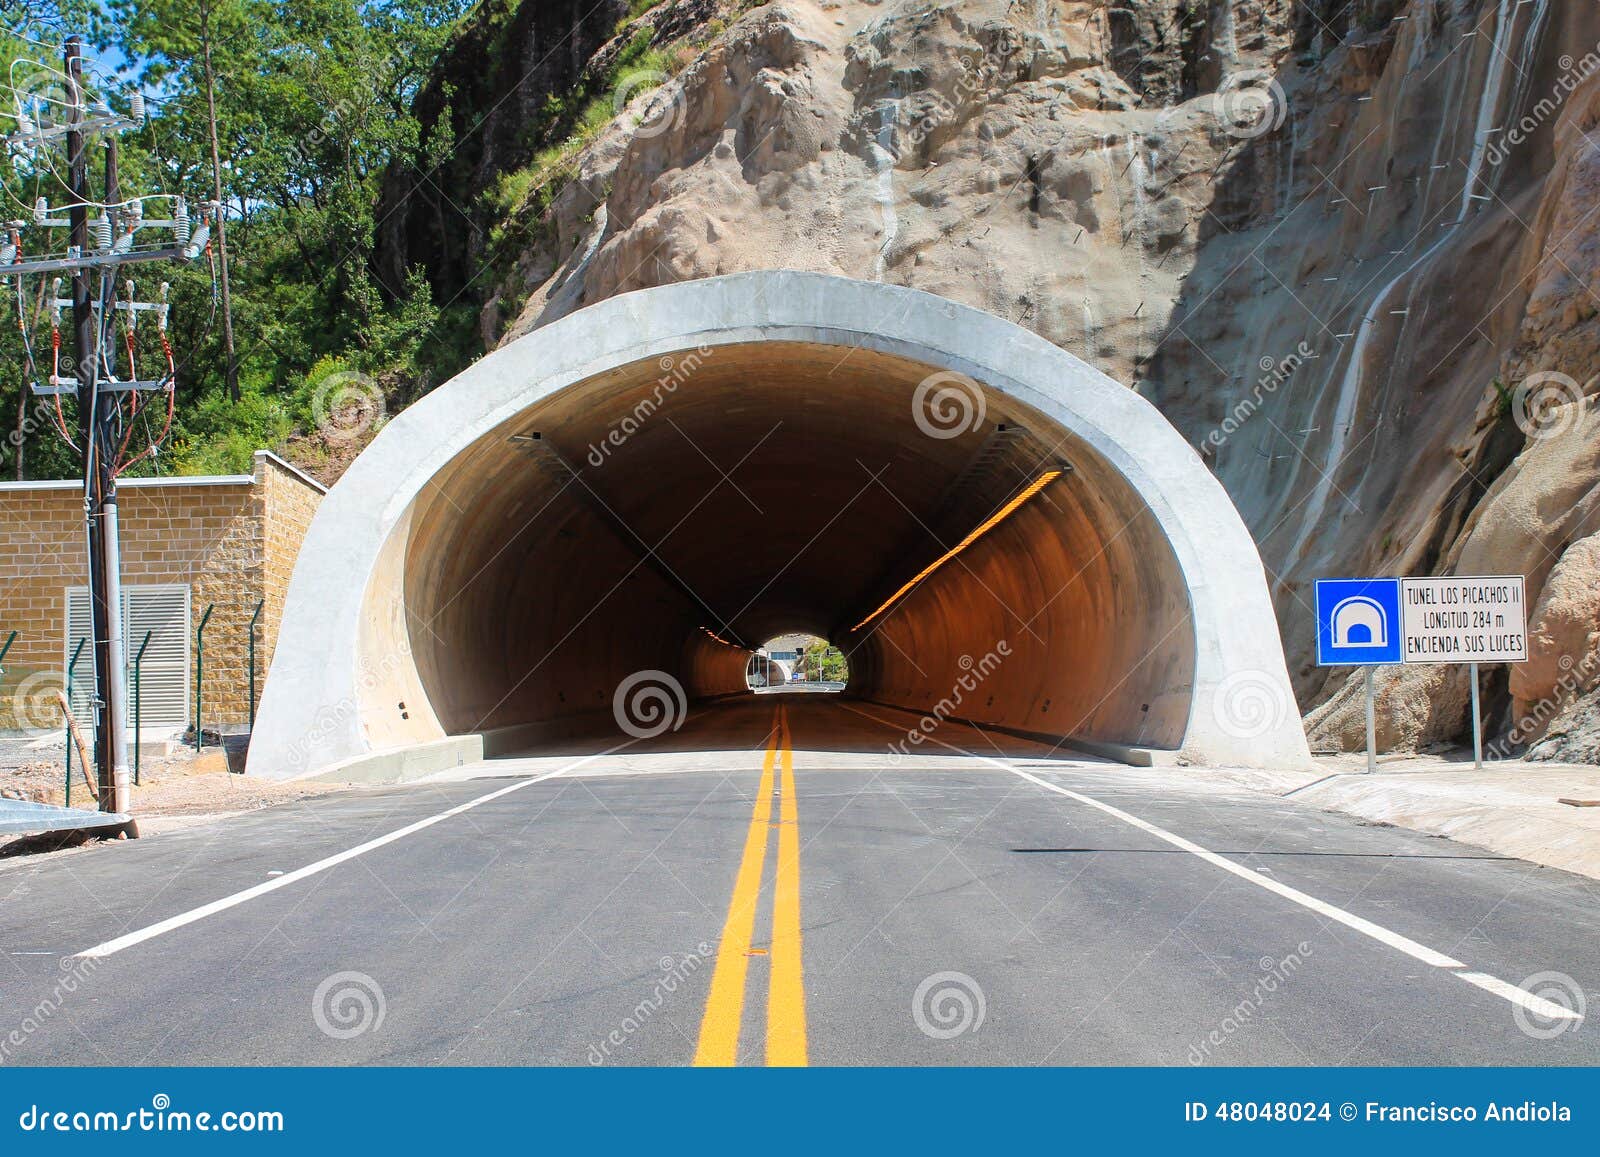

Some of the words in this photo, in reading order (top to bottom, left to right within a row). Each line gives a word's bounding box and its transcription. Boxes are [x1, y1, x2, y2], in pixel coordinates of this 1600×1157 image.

[1407, 588, 1437, 605] TUNEL
[1441, 587, 1458, 604] LOS
[1463, 586, 1508, 604] PICACHOS
[1424, 612, 1469, 629] LONGITUD
[1473, 611, 1491, 628] 284
[1496, 614, 1504, 628] m
[1407, 636, 1459, 654] ENCIENDA
[1465, 635, 1484, 652] SUS
[1490, 634, 1522, 652] LUCES
